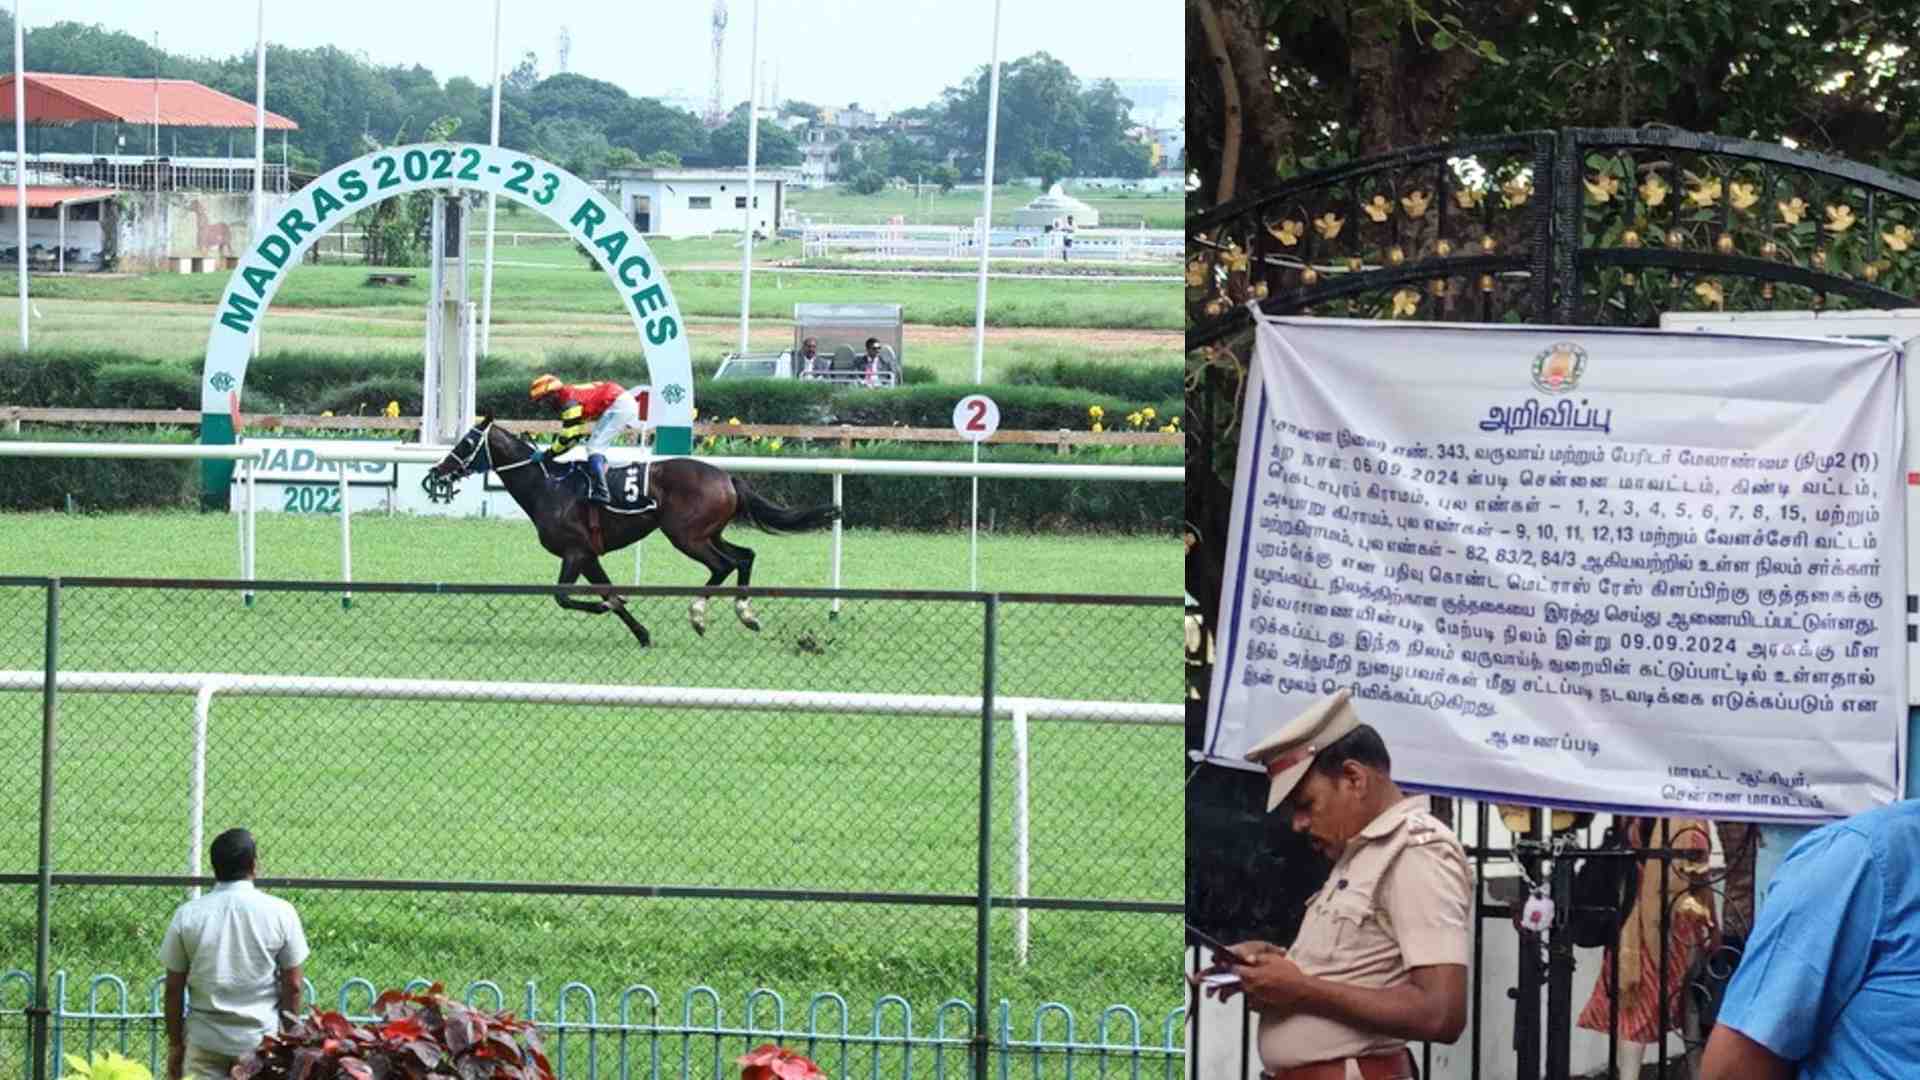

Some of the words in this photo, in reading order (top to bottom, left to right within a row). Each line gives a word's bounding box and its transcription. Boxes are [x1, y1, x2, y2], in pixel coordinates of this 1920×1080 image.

[220, 169, 369, 334] MADRAS
[372, 148, 560, 205] 2022-23
[570, 198, 678, 345] RACES
[966, 399, 986, 431] 2
[1479, 398, 1612, 435] அறிவிப்பு
[1475, 444, 1545, 465] வருவாய்
[1550, 444, 1605, 466] மற்றும்
[624, 475, 640, 502] 5
[1519, 469, 1608, 489] சென்னை
[1598, 500, 1614, 518] 2,
[1624, 501, 1640, 518] 3,
[1780, 504, 1806, 523] 15,
[1816, 505, 1879, 527] மற்றும்
[1516, 523, 1530, 541] 9,
[1537, 524, 1558, 542] 10,
[1640, 526, 1697, 548] மற்றும்
[1705, 529, 1808, 548] வேளச்சேரி
[1756, 556, 1802, 578] நிலம்
[1651, 579, 1750, 605] கிளப்பிற்கு
[1759, 584, 1883, 609] குத்தகைக்கு
[1504, 624, 1547, 644] நிலம்
[1555, 627, 1611, 652] இன்று
[1620, 632, 1737, 653] 09.09.2024
[1639, 659, 1766, 683] கட்டுப்பாட்டில்
[1774, 665, 1875, 688] உள்ளதால்
[1600, 685, 1704, 709] நடவடிக்கை
[1712, 690, 1833, 713] எடுக்கப்படும்
[1484, 731, 1600, 757] ஆணைப்படி
